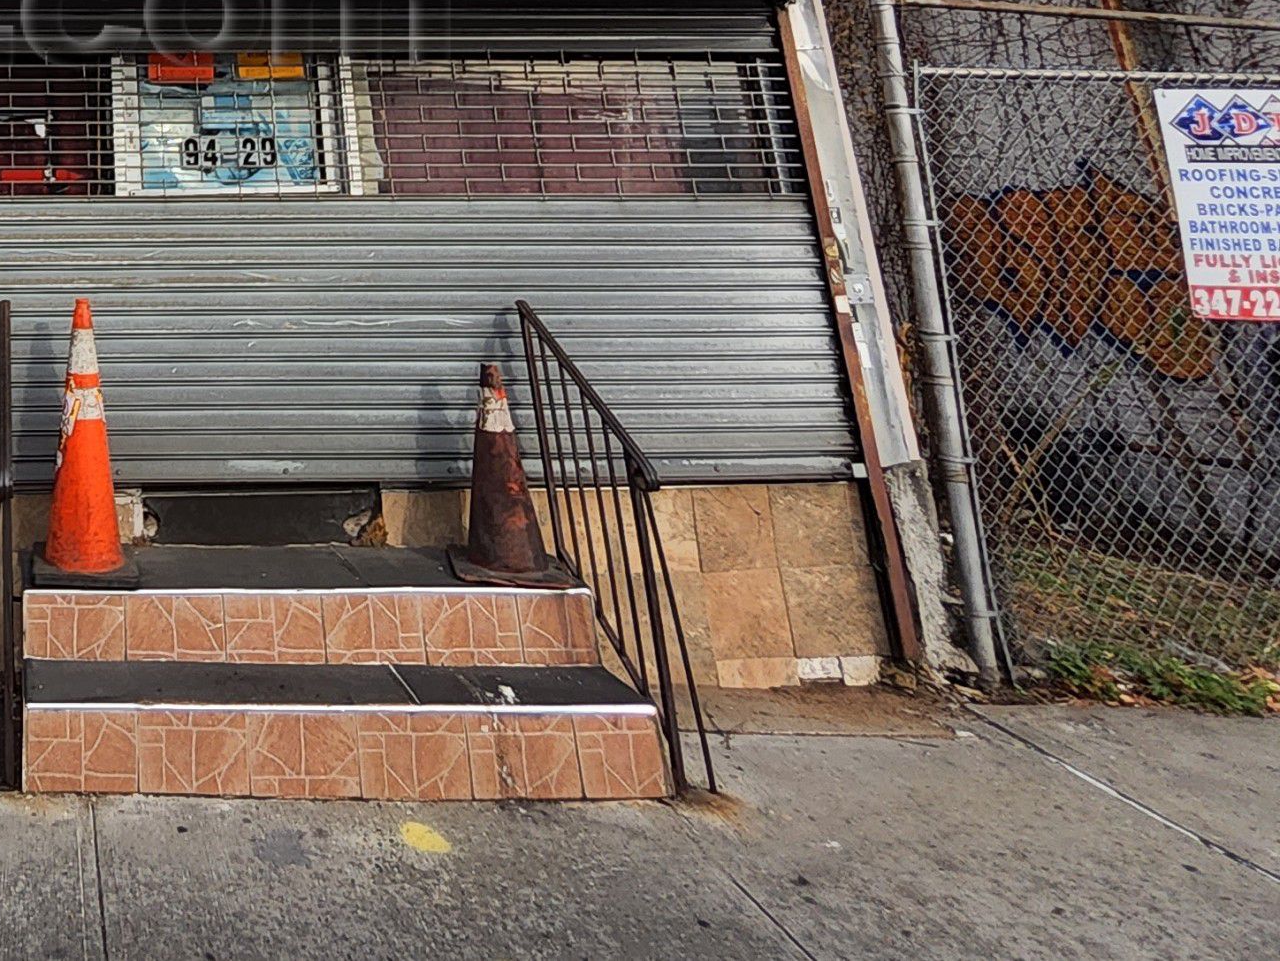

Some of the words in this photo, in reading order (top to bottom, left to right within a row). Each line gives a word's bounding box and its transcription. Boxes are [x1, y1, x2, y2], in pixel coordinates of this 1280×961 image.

[1190, 238, 1262, 251] FINISHED
[1193, 254, 1252, 268] FULLY
[1228, 269, 1241, 283] &
